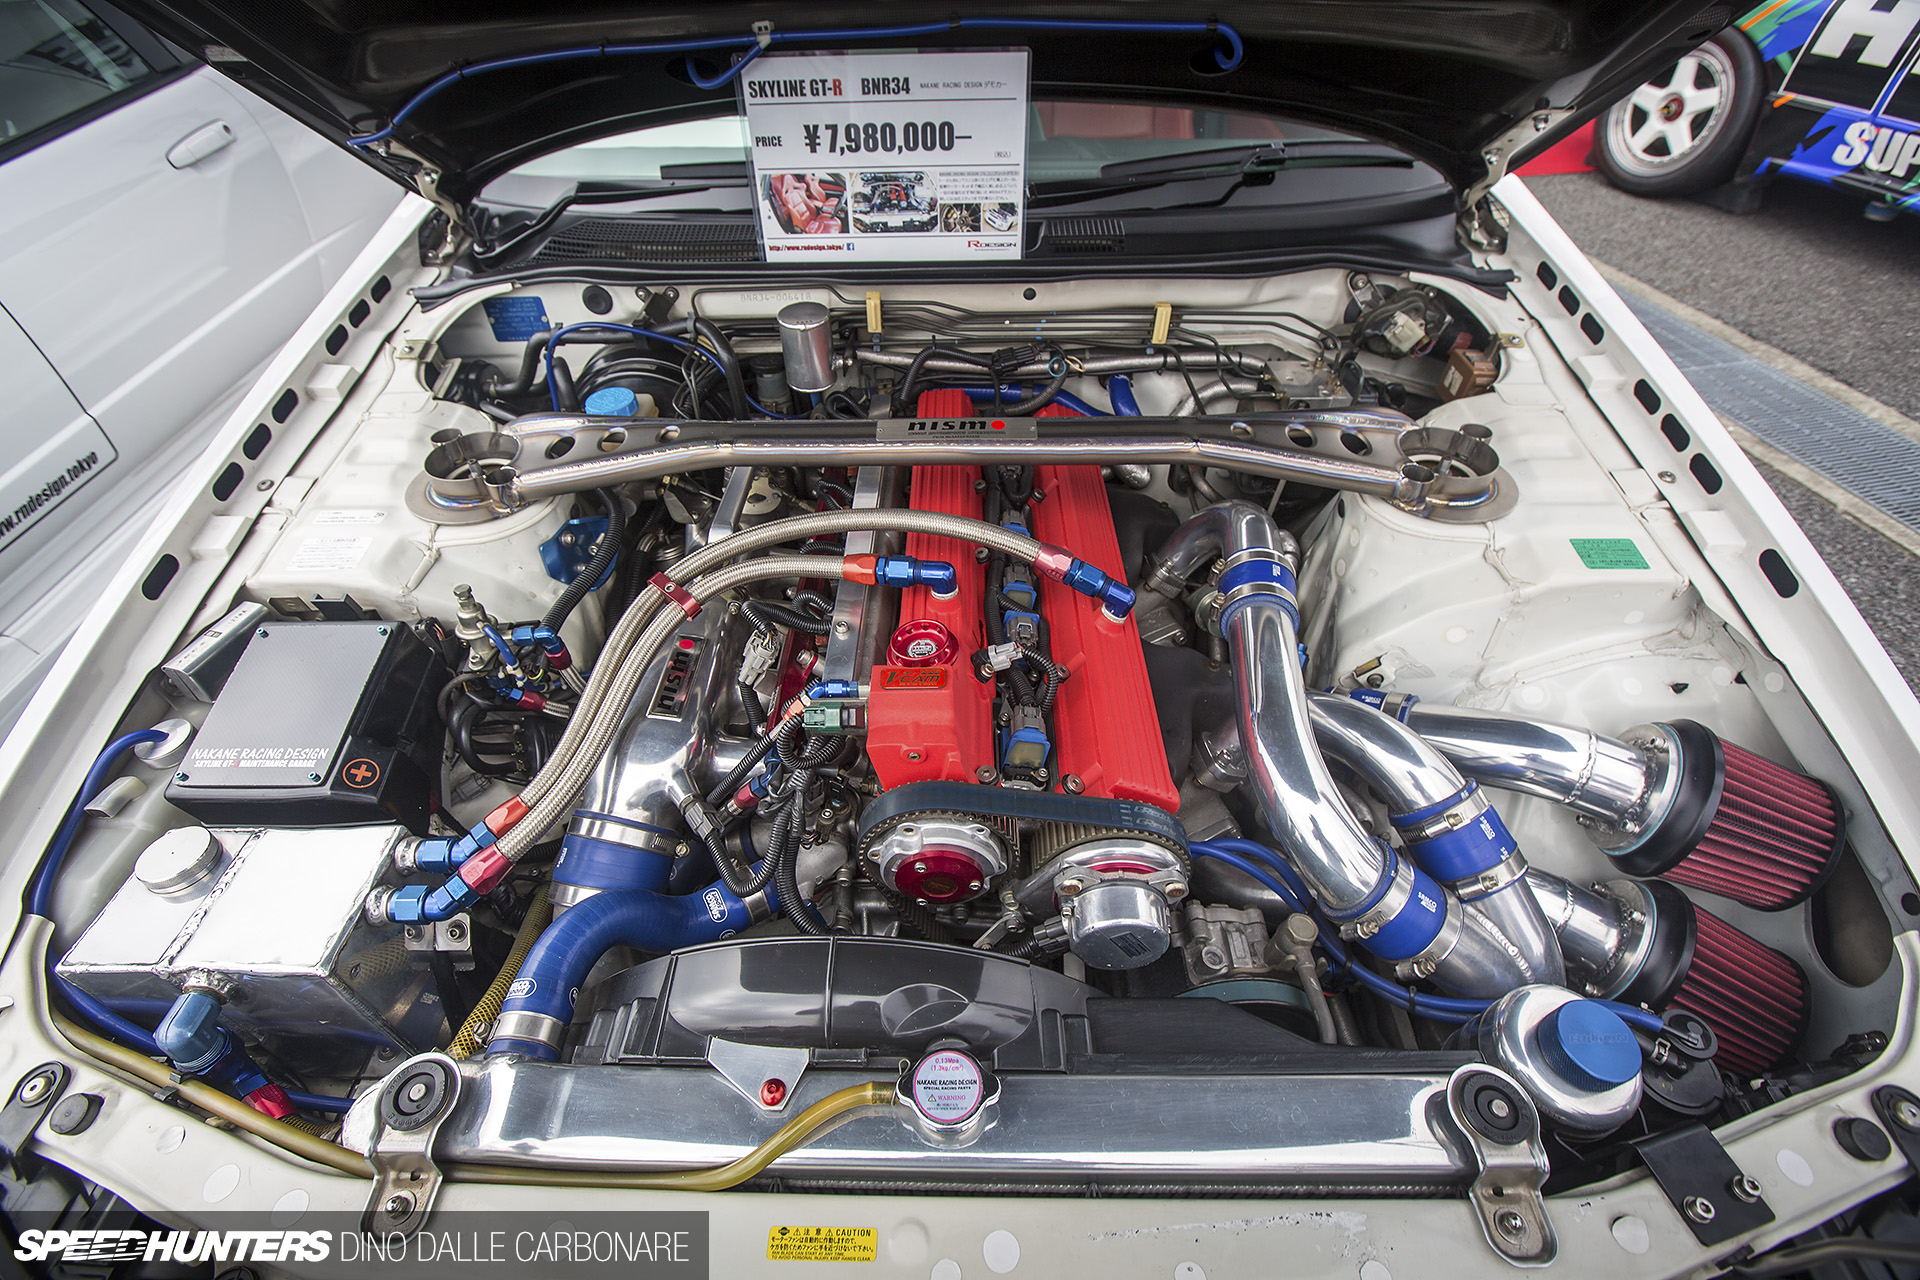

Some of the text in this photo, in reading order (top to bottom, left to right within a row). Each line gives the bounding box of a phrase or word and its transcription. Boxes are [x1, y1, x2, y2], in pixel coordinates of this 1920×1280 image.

[1810, 0, 1920, 75] H
[748, 77, 911, 98] SKYLINE GT-R BNR34
[964, 81, 983, 89] DESIGN
[755, 135, 783, 147] PRICE
[191, 747, 329, 760] NAKANE RACING DESIGN
[193, 760, 317, 768] SKYLINE GT-R MAINTENANCE GARAGE
[836, 1229, 871, 1237] CAUTION
